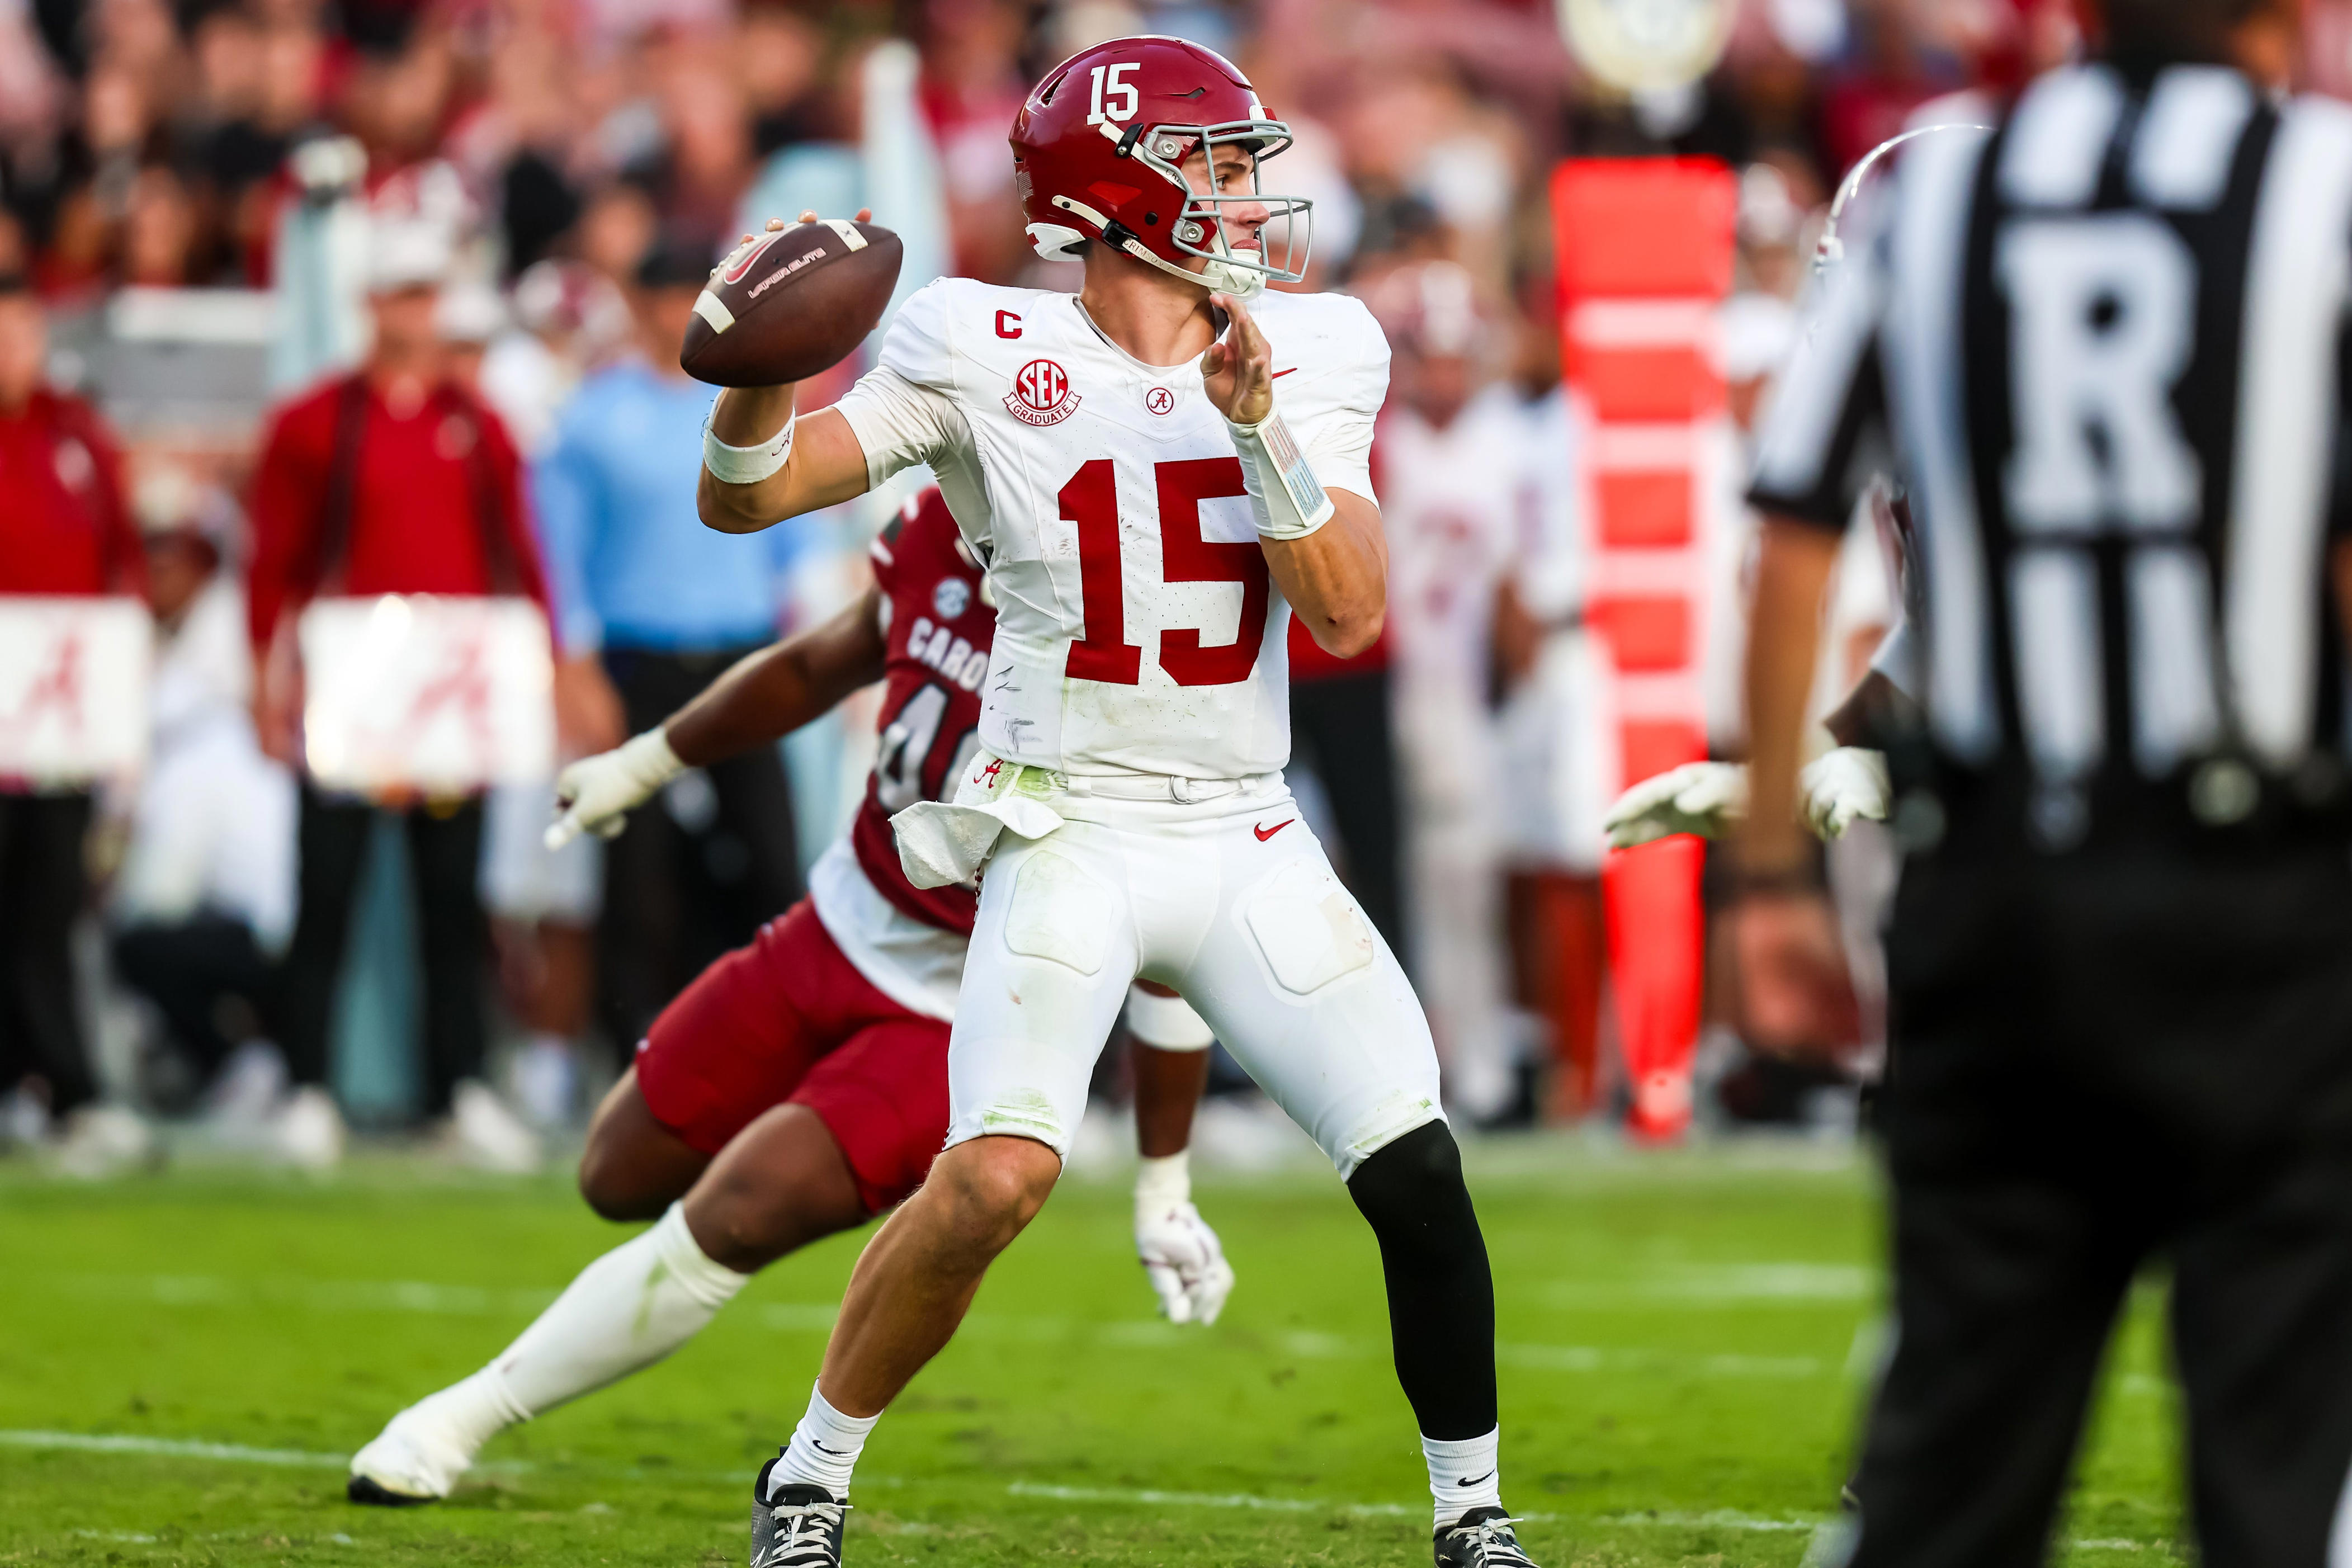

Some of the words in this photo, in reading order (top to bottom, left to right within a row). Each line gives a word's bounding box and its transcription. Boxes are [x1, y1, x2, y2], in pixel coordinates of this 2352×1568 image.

[1087, 63, 1141, 125] 15
[748, 267, 791, 299] VAPOR
[788, 247, 826, 273] ELITE
[995, 309, 1022, 339] C
[1018, 362, 1065, 409] SEC
[1992, 213, 2202, 531] R
[1013, 404, 1071, 424] GRADUATE
[1150, 392, 1169, 409] A
[1058, 457, 1269, 686] 15
[907, 617, 989, 698] CARO
[973, 758, 1005, 788] A
